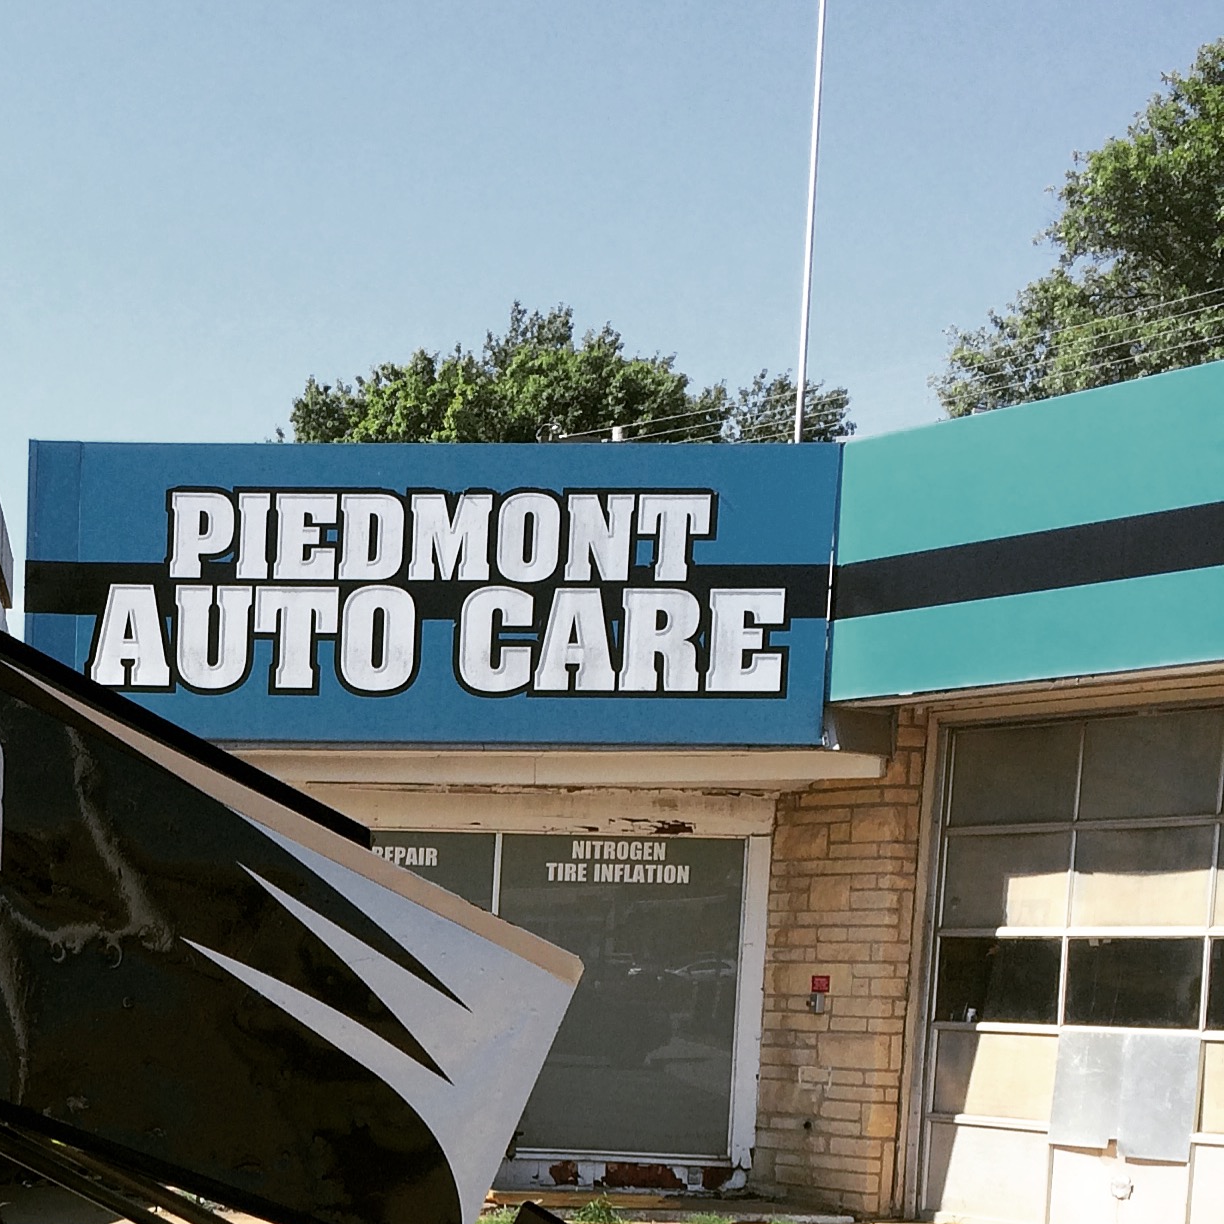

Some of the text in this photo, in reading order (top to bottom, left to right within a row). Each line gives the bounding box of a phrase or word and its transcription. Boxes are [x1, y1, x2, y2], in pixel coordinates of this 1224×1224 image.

[168, 491, 714, 582] PIEDMONT
[90, 583, 786, 693] AUTO CARE
[546, 862, 690, 884] TIRE INFLATION
[571, 840, 667, 861] NITROGEN
